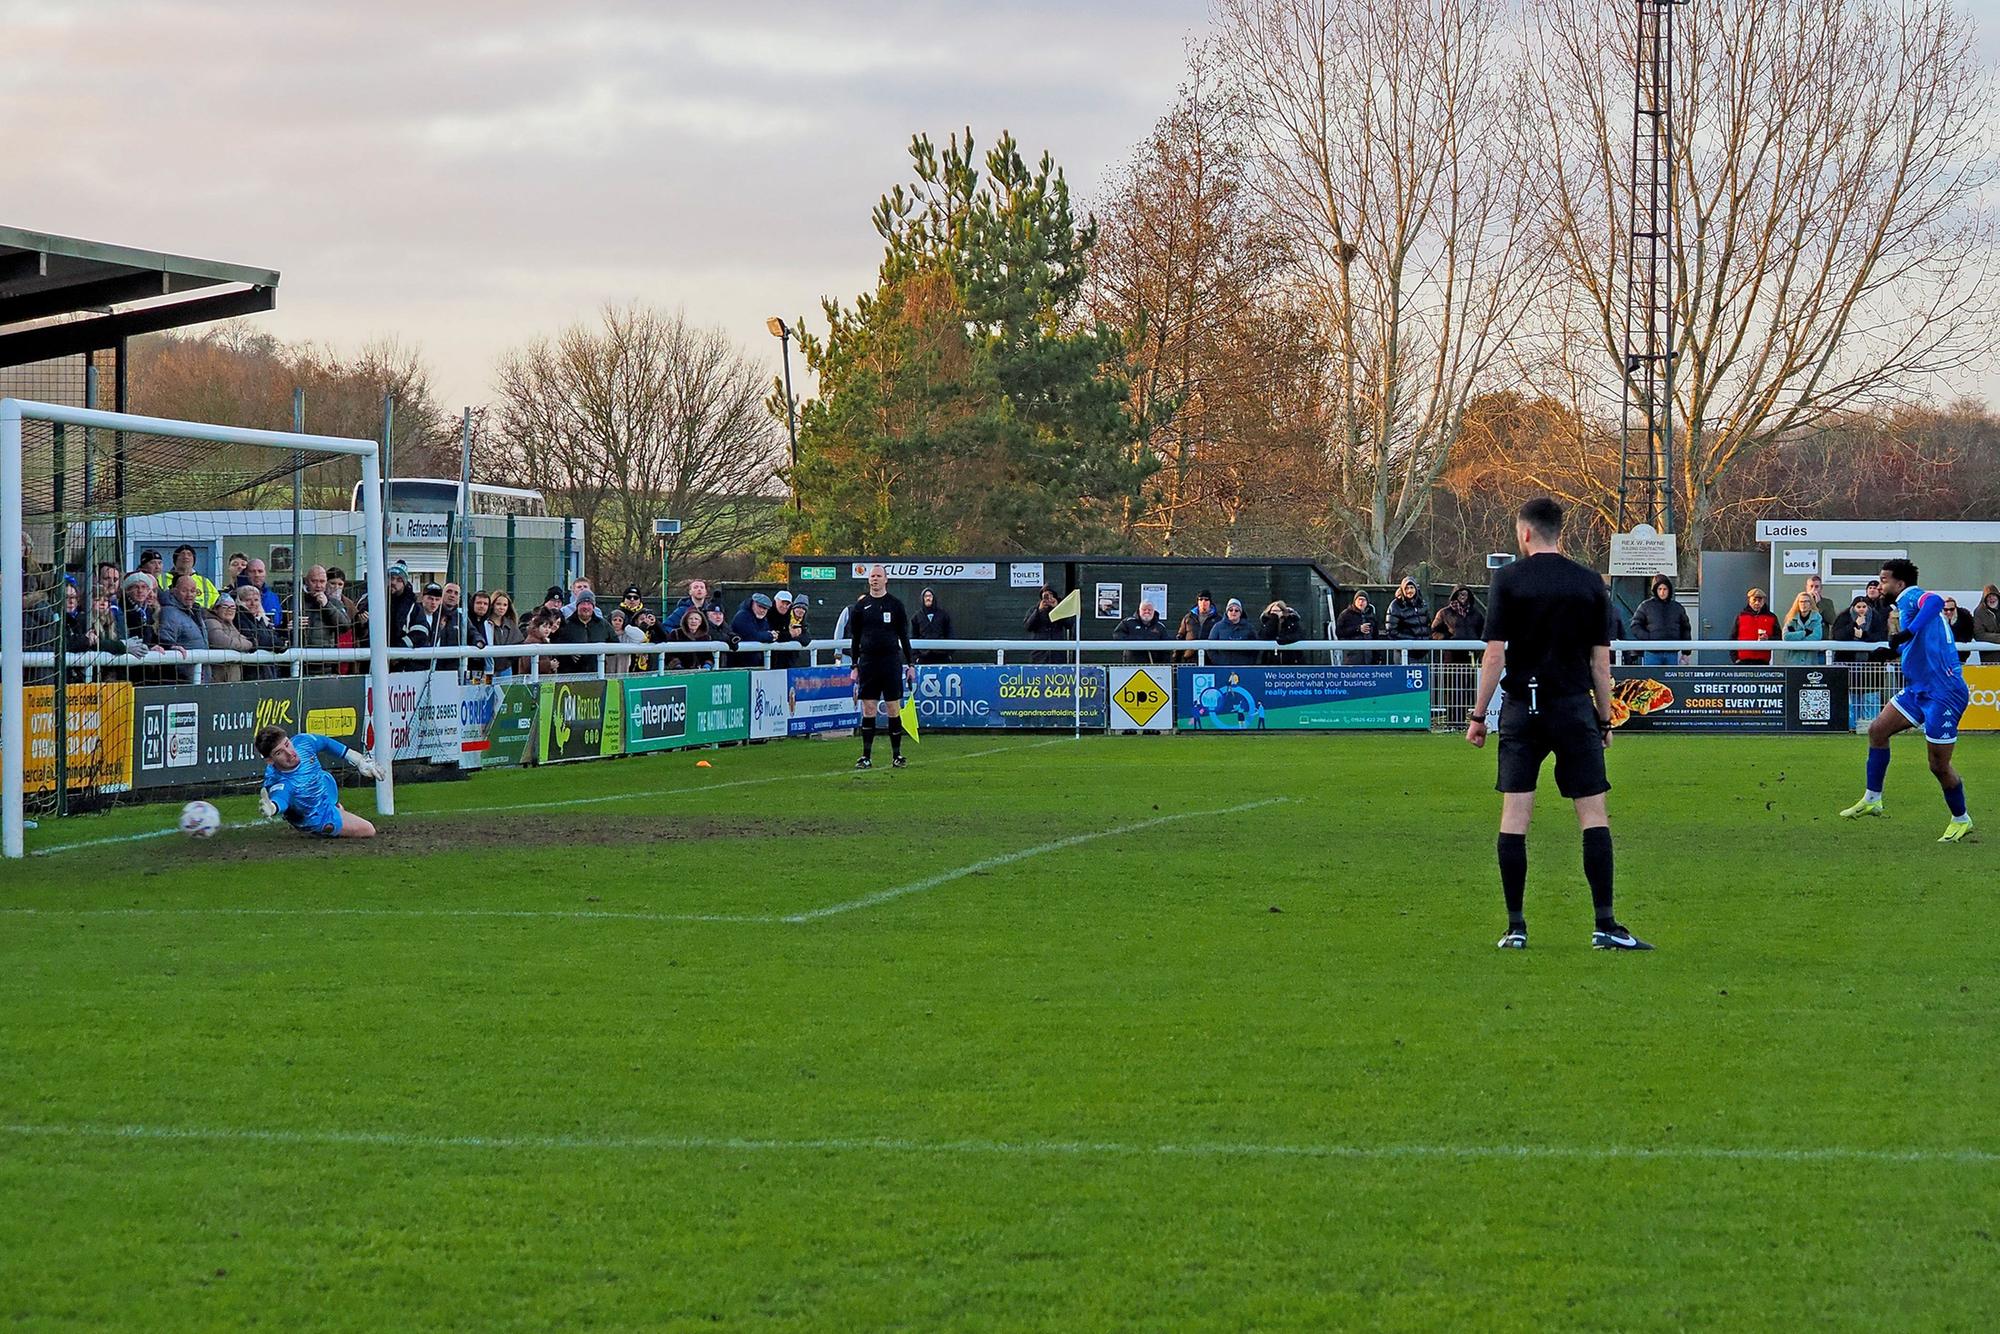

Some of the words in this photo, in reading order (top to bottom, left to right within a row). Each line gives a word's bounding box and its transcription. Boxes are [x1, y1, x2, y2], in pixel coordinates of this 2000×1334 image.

[1765, 525, 1808, 536] Ladies
[885, 565, 919, 576] CLUB
[922, 565, 965, 576] SHOP
[998, 673, 1023, 686] Call
[1027, 676, 1041, 686] us
[1044, 674, 1077, 686] NOW
[1081, 676, 1098, 686] on
[1264, 671, 1277, 681] We
[1278, 671, 1295, 681] look
[1296, 671, 1325, 683] beyond
[1326, 671, 1340, 680] the
[1341, 670, 1370, 680] balance
[1371, 670, 1393, 680] sheet
[1406, 669, 1422, 679] HB
[999, 686, 1040, 698] 02476
[1044, 686, 1070, 698] 644
[1265, 680, 1272, 689] to
[1274, 680, 1305, 690] pinpoint
[1306, 680, 1324, 688] what
[1325, 681, 1342, 690] your
[1343, 680, 1376, 688] business
[1265, 688, 1287, 698] really
[1324, 688, 1349, 696] thrive.
[1693, 684, 1730, 694] STREET
[1731, 684, 1757, 694] FOOD
[1758, 684, 1784, 694] THAT
[388, 684, 416, 720] Knight
[711, 684, 723, 705] HERE
[723, 683, 732, 704] FOR
[1124, 687, 1158, 707] bps
[1685, 698, 1724, 708] SCORES
[1725, 698, 1756, 708] EVERY
[1756, 698, 1783, 708] TIME
[213, 711, 254, 731] FOLLOW
[254, 698, 294, 738] YOUR
[630, 696, 686, 731] enterprise
[698, 711, 707, 732] THE
[707, 709, 728, 731] NATIONAL
[728, 707, 744, 729] LEAGUE
[147, 716, 161, 735] DA
[390, 721, 411, 749] rank
[147, 739, 161, 759] ZN
[206, 745, 233, 764] CLUB
[238, 743, 255, 761] ALL
